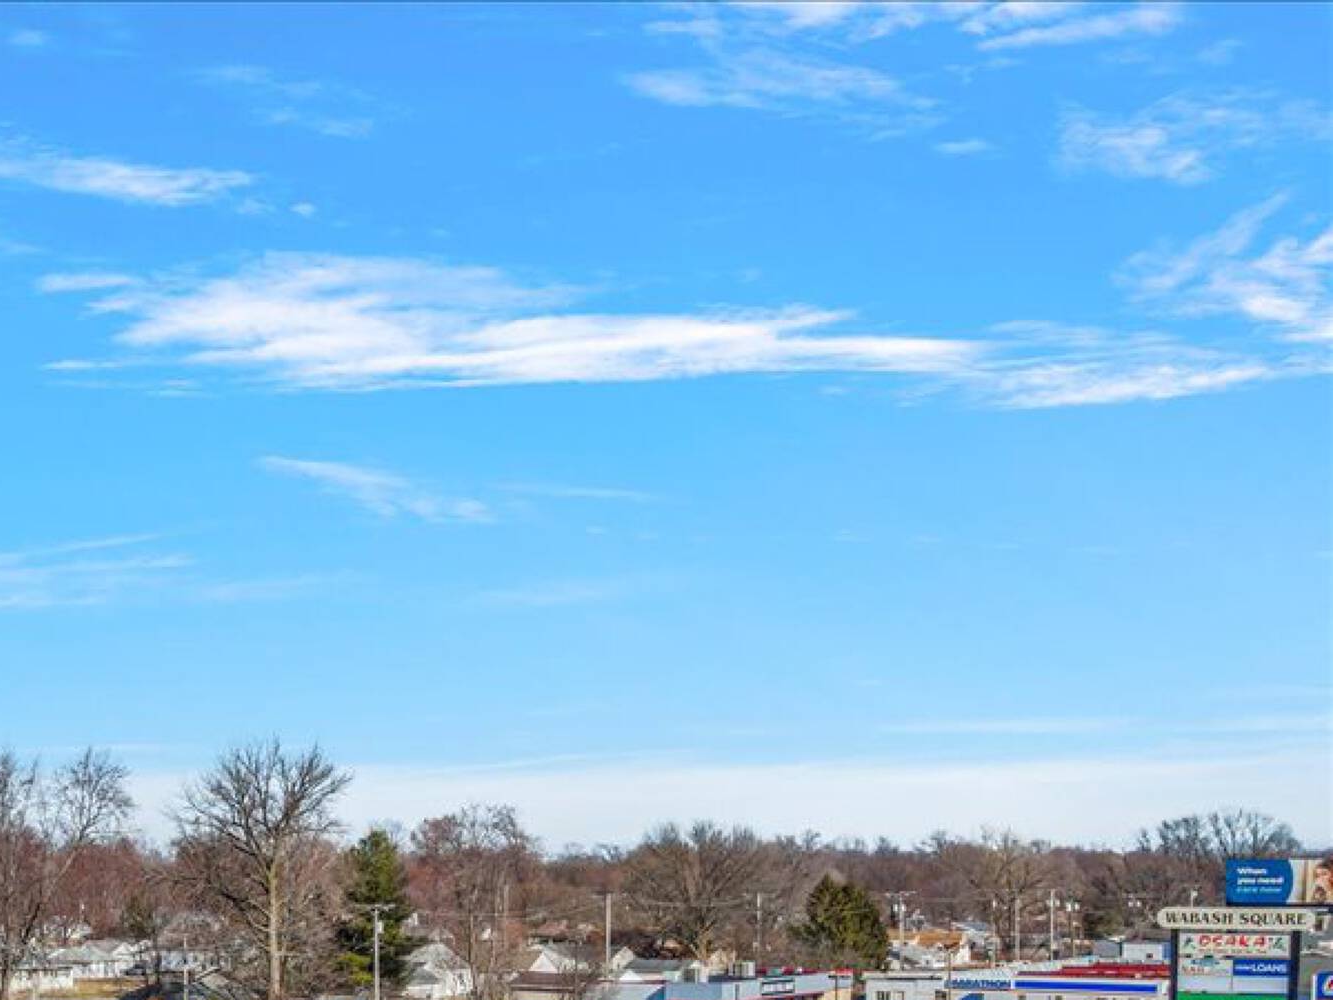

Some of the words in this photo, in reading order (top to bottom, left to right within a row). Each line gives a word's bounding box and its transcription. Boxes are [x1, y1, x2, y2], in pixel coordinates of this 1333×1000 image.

[1166, 912, 1233, 924] WABASH
[1239, 912, 1306, 926] SQUARE
[1252, 963, 1287, 972] LOANS
